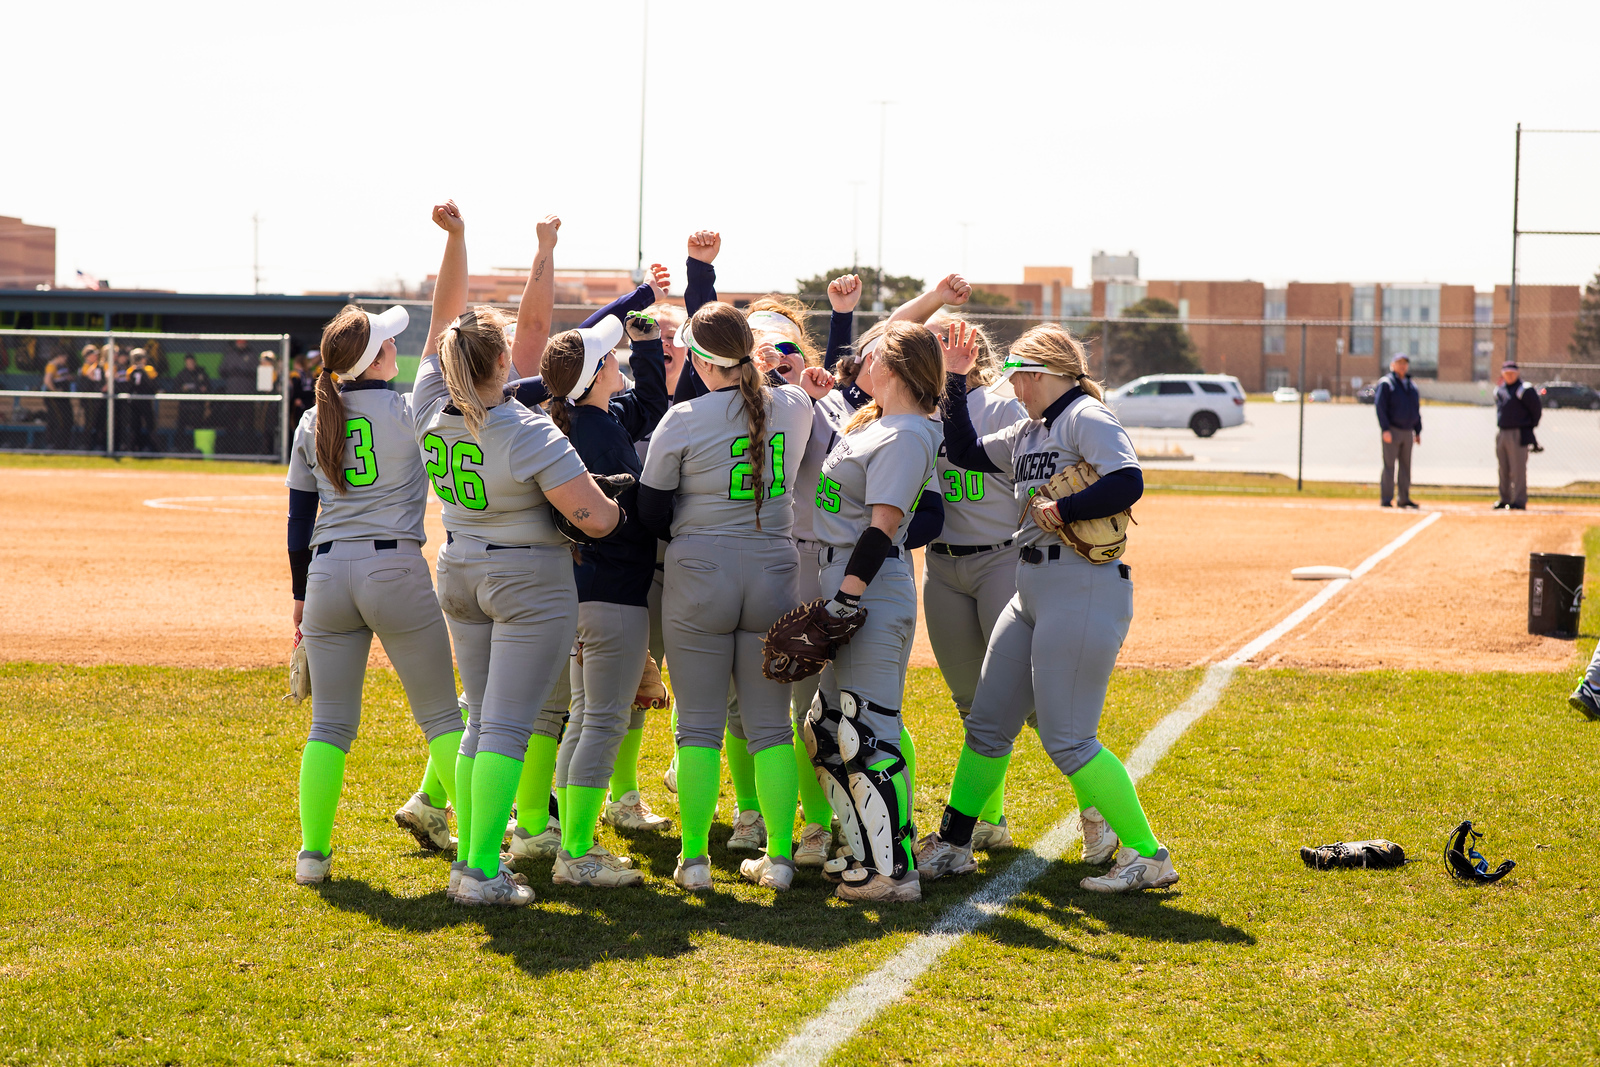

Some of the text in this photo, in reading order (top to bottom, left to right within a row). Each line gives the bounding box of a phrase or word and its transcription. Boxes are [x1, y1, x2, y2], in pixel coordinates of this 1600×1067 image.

[344, 416, 379, 487] 3
[424, 432, 489, 510] 26
[728, 432, 786, 500] 21
[943, 469, 985, 502] 30
[815, 470, 842, 514] 25
